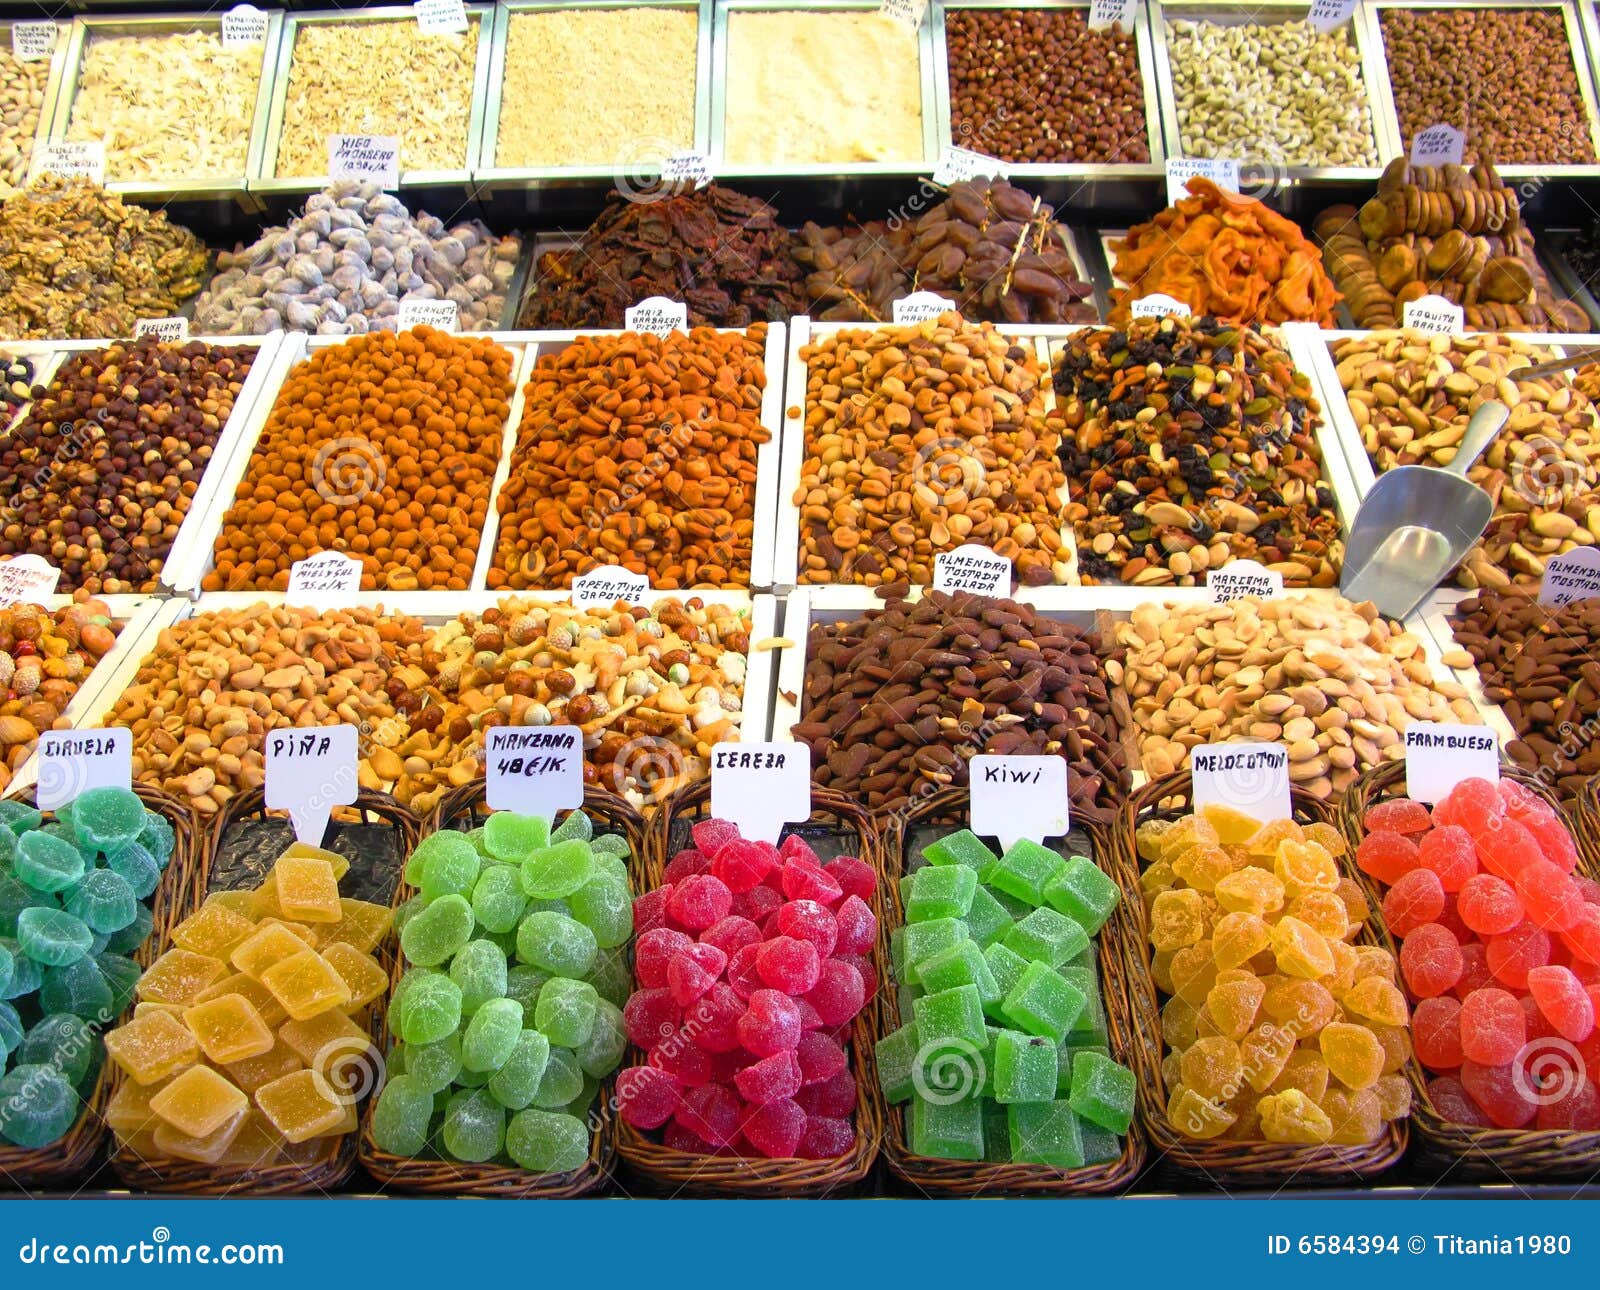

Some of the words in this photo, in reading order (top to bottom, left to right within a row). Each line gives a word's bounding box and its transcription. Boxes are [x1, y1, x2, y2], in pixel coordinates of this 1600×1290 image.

[1412, 319, 1453, 333] BRASIL
[938, 554, 1008, 574] ALMENDRA
[944, 565, 1000, 583] TOSTADA
[1551, 575, 1600, 591] TOSTAD
[576, 579, 646, 593] APERITIVO
[943, 577, 995, 592] SALADA
[1214, 584, 1274, 597] TOSTADA
[580, 590, 641, 602] JAPONES
[44, 737, 117, 757] CIRUELA
[492, 733, 576, 751] MANZANA
[1406, 732, 1494, 751] FRAMBUESA
[715, 751, 786, 770] CEREZA
[1195, 752, 1287, 772] MELOCOTON
